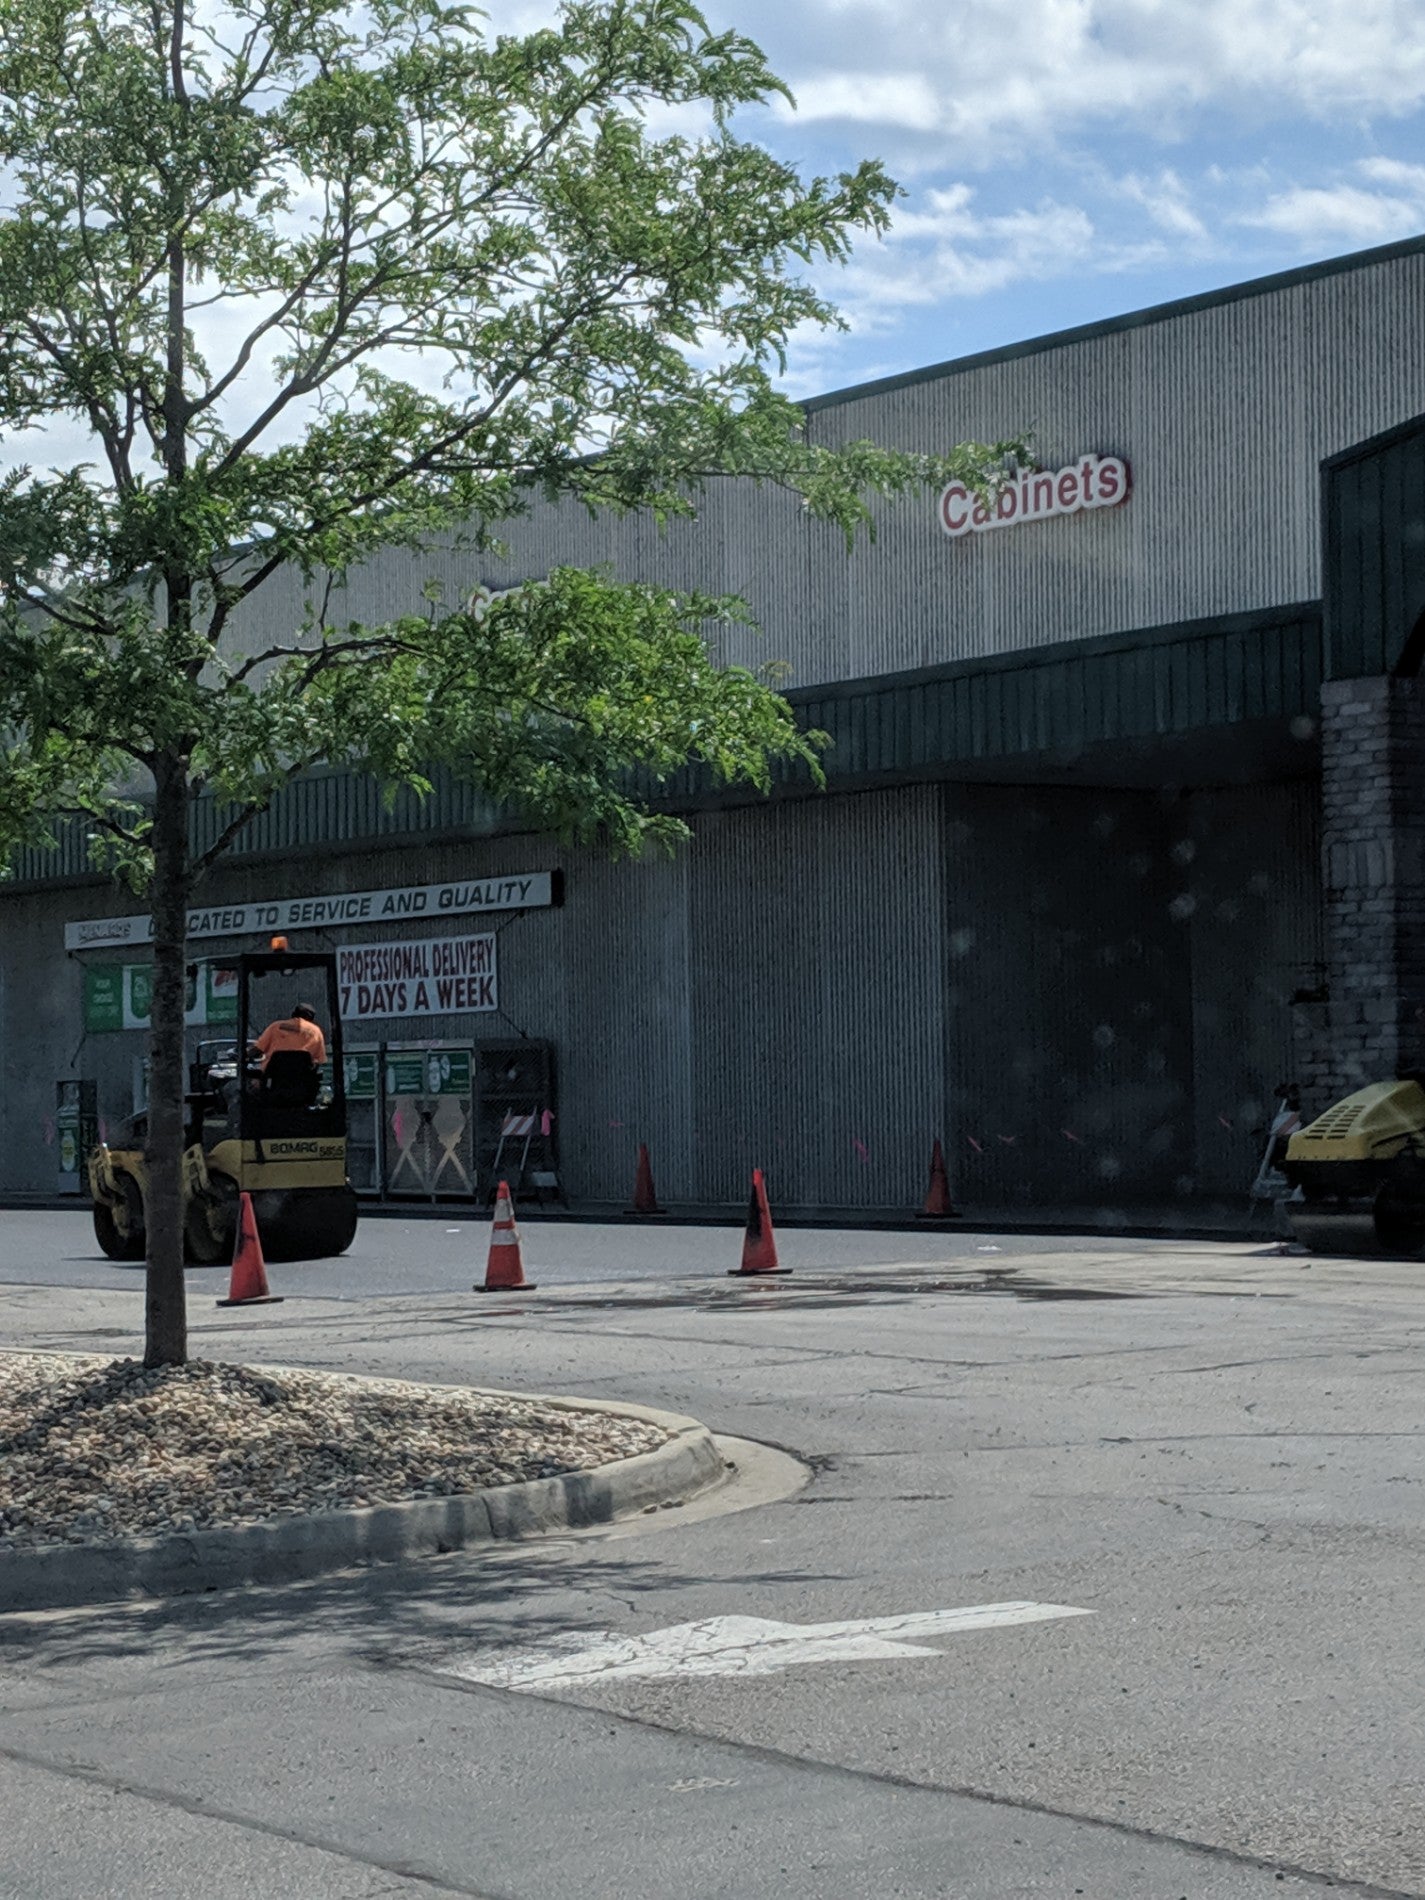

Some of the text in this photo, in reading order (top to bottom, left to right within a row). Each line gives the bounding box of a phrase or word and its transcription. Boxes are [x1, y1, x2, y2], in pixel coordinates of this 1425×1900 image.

[942, 461, 1119, 530] Cabinets
[147, 909, 246, 937] DCATED
[256, 905, 279, 927] TO
[288, 896, 373, 924] SERVICE
[381, 891, 428, 915] AND
[438, 879, 533, 909] QUALITY
[340, 938, 494, 984] PROFESSIONAL DELIVERY
[340, 975, 495, 1015] 7 DAYS A WEEK
[270, 1141, 319, 1154] BOMAG
